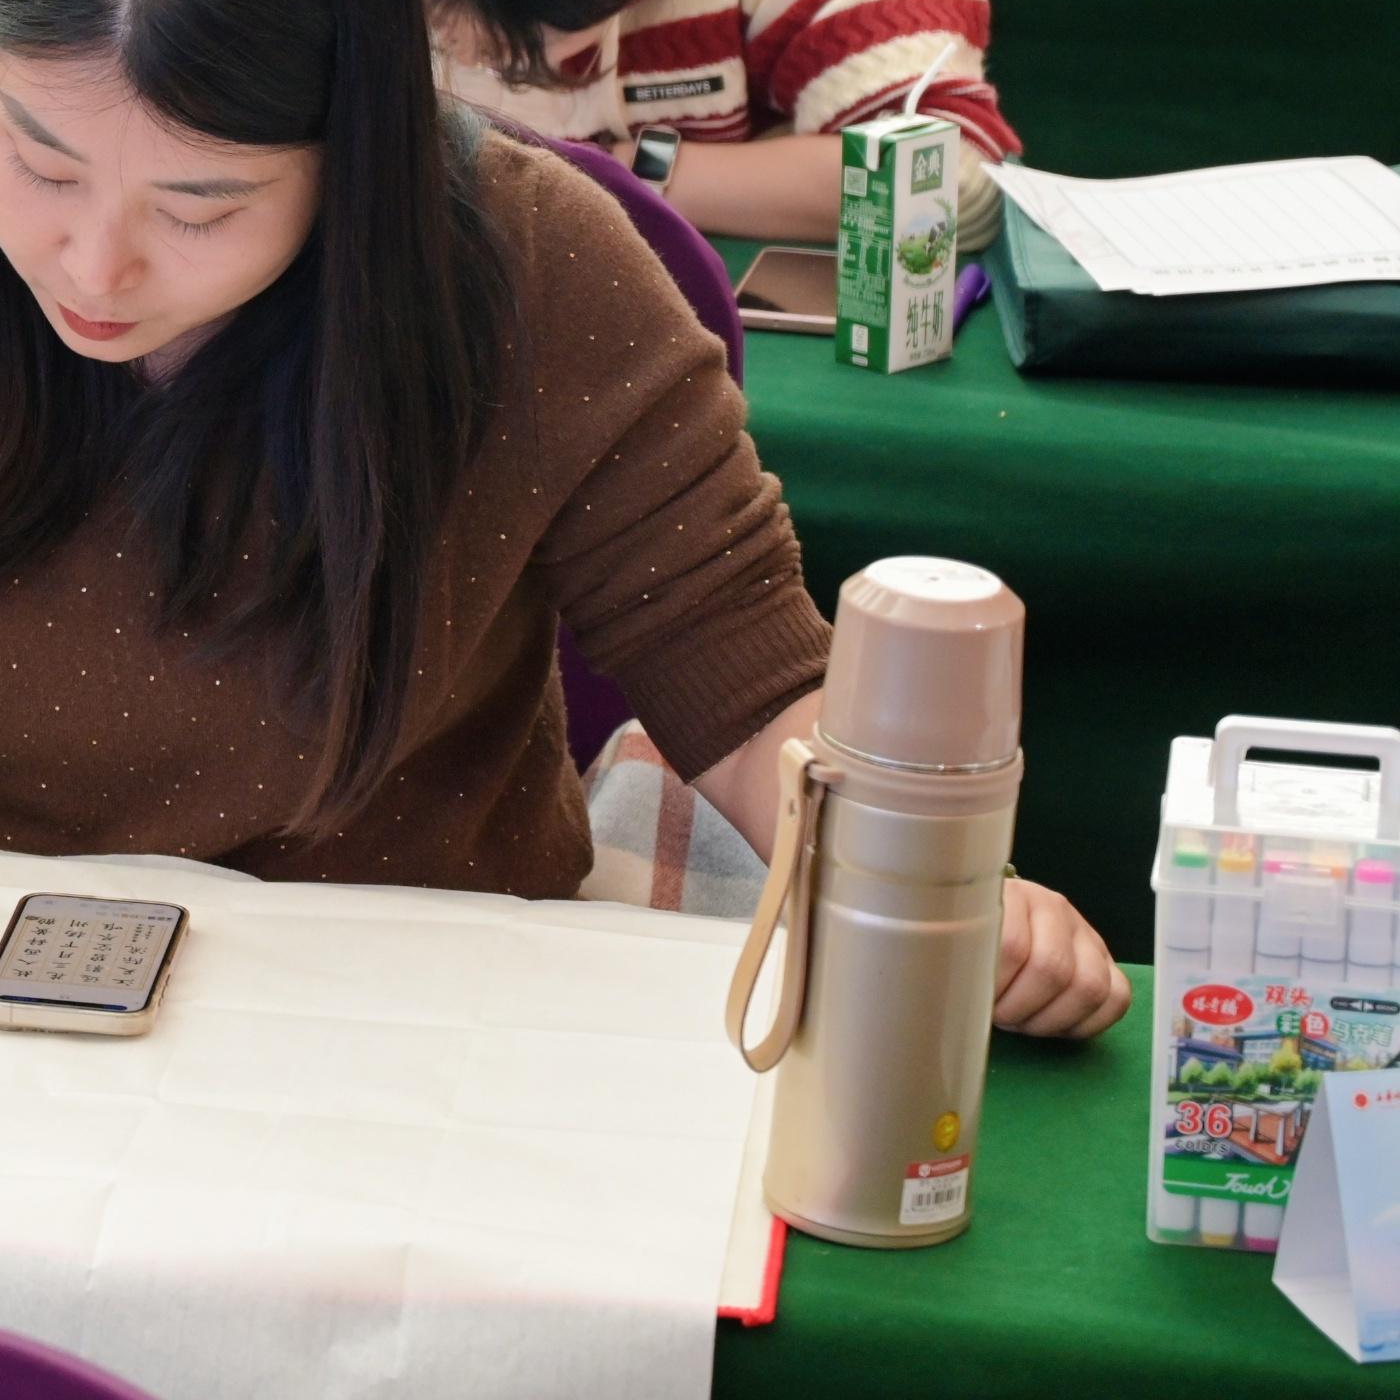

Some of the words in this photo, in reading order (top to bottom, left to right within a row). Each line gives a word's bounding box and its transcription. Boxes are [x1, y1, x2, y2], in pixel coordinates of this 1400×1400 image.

[635, 80, 712, 102] BETTERDAYS
[914, 153, 941, 183] 金典
[906, 290, 945, 348] 纯牛奶
[1265, 985, 1313, 1007] 双头
[1175, 1101, 1233, 1138] 36
